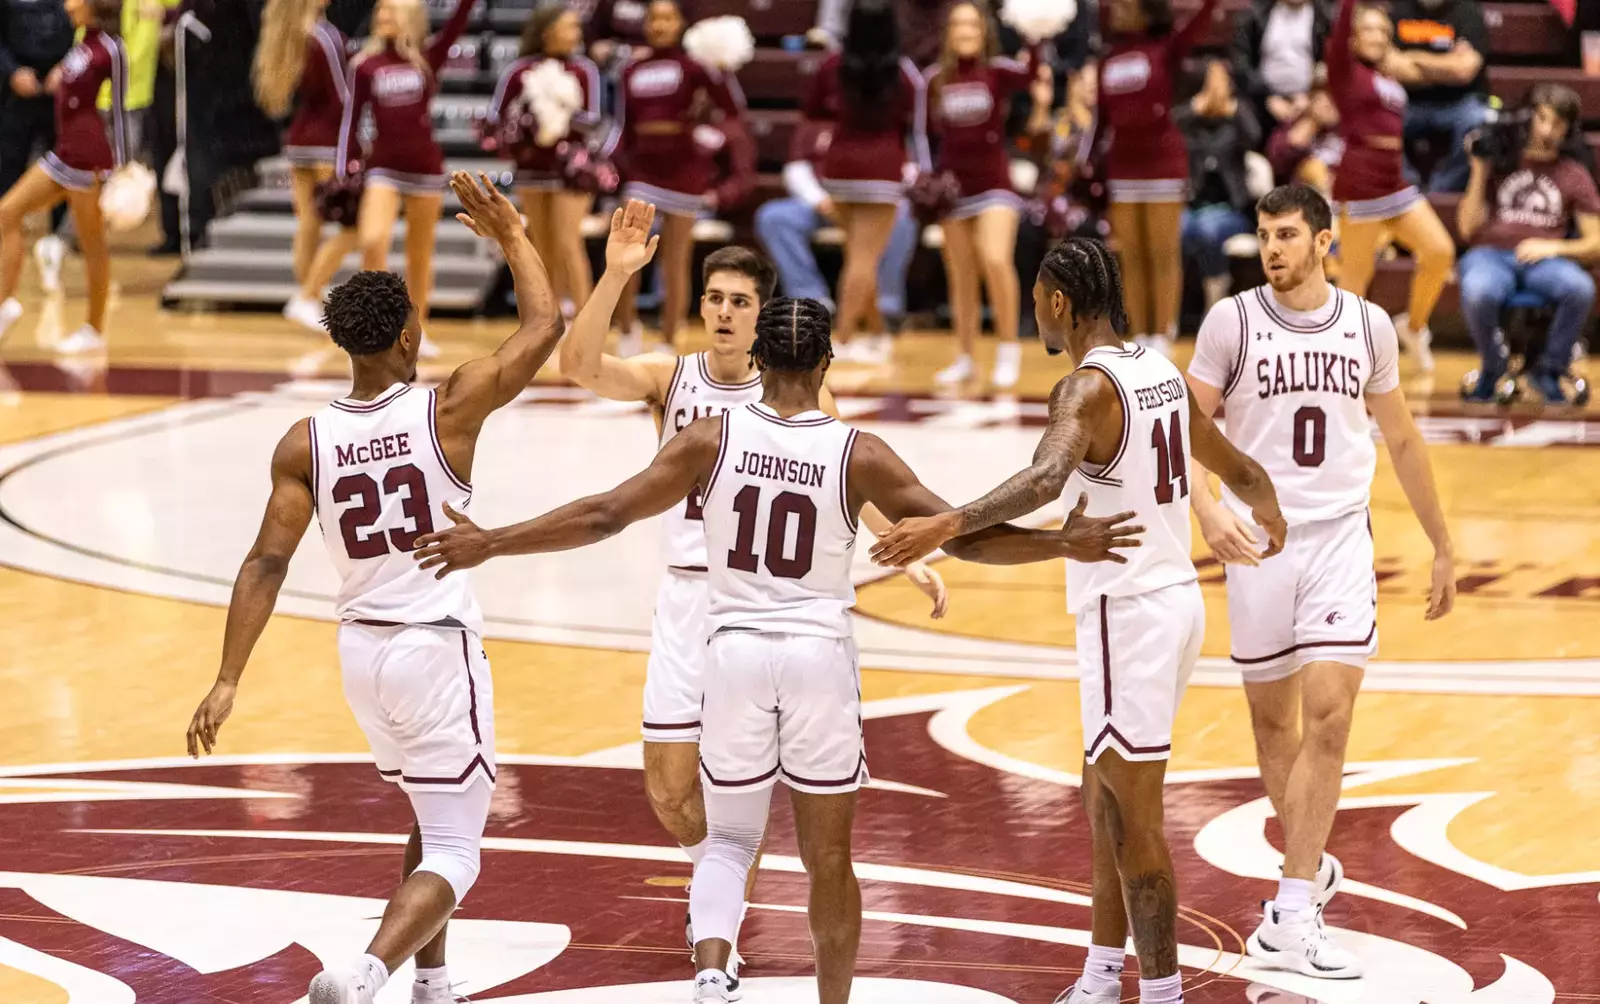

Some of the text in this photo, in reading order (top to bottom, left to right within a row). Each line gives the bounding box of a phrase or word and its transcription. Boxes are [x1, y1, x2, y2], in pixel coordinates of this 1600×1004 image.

[1257, 351, 1360, 400] SALUKIS
[335, 432, 412, 468] McGEE
[1151, 410, 1189, 505] 14
[1292, 406, 1326, 468] 0
[735, 451, 826, 488] JOHNSON
[331, 463, 434, 559] 23
[727, 484, 817, 580] 10
